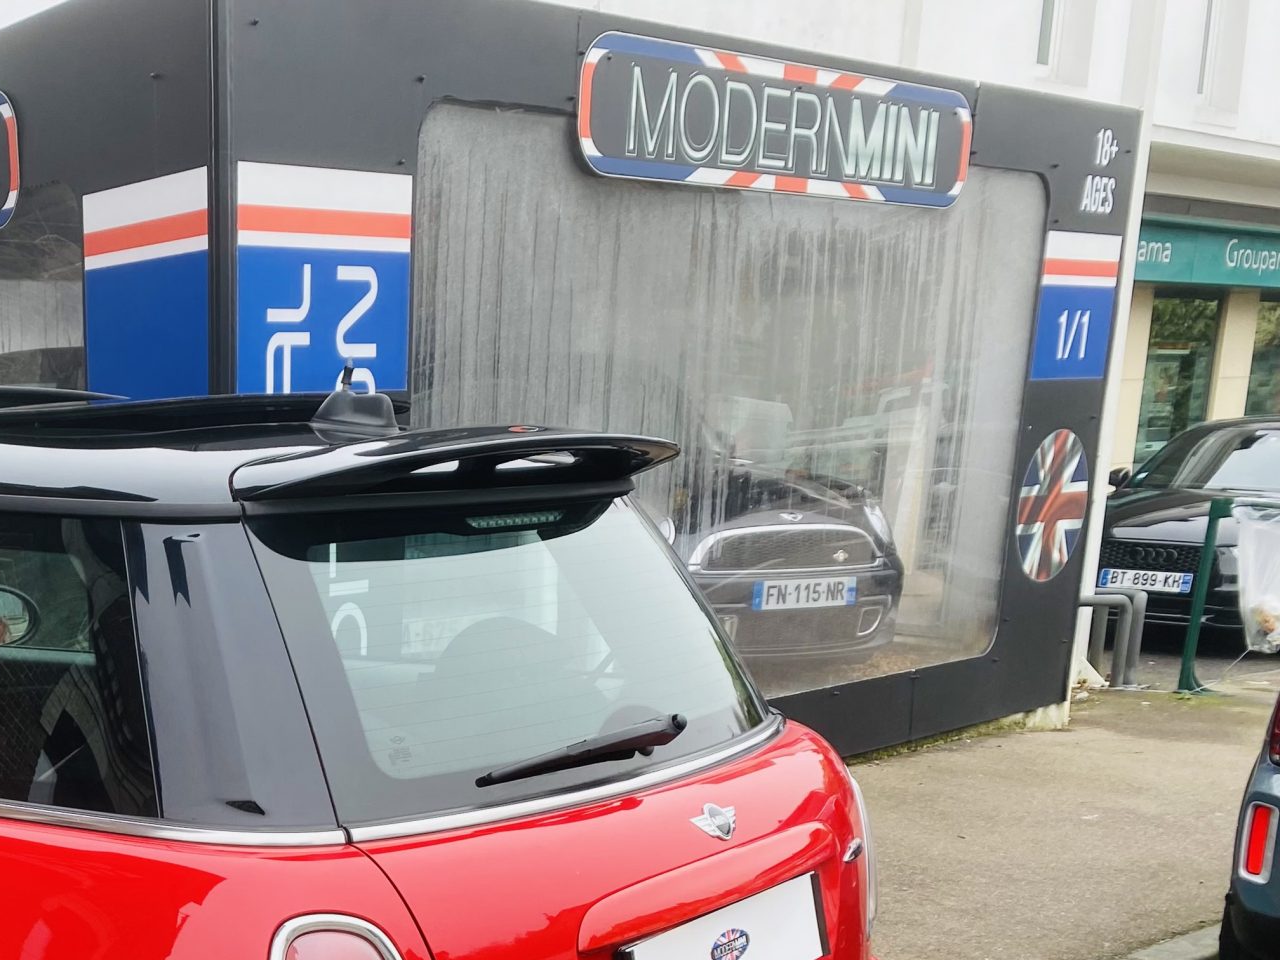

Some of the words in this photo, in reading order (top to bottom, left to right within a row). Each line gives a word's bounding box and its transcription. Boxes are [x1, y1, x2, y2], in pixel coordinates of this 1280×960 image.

[1095, 128, 1120, 168] 18+
[1079, 174, 1116, 215] AGES
[1055, 308, 1091, 361] 1/1
[765, 580, 846, 606] FN-115-NR
